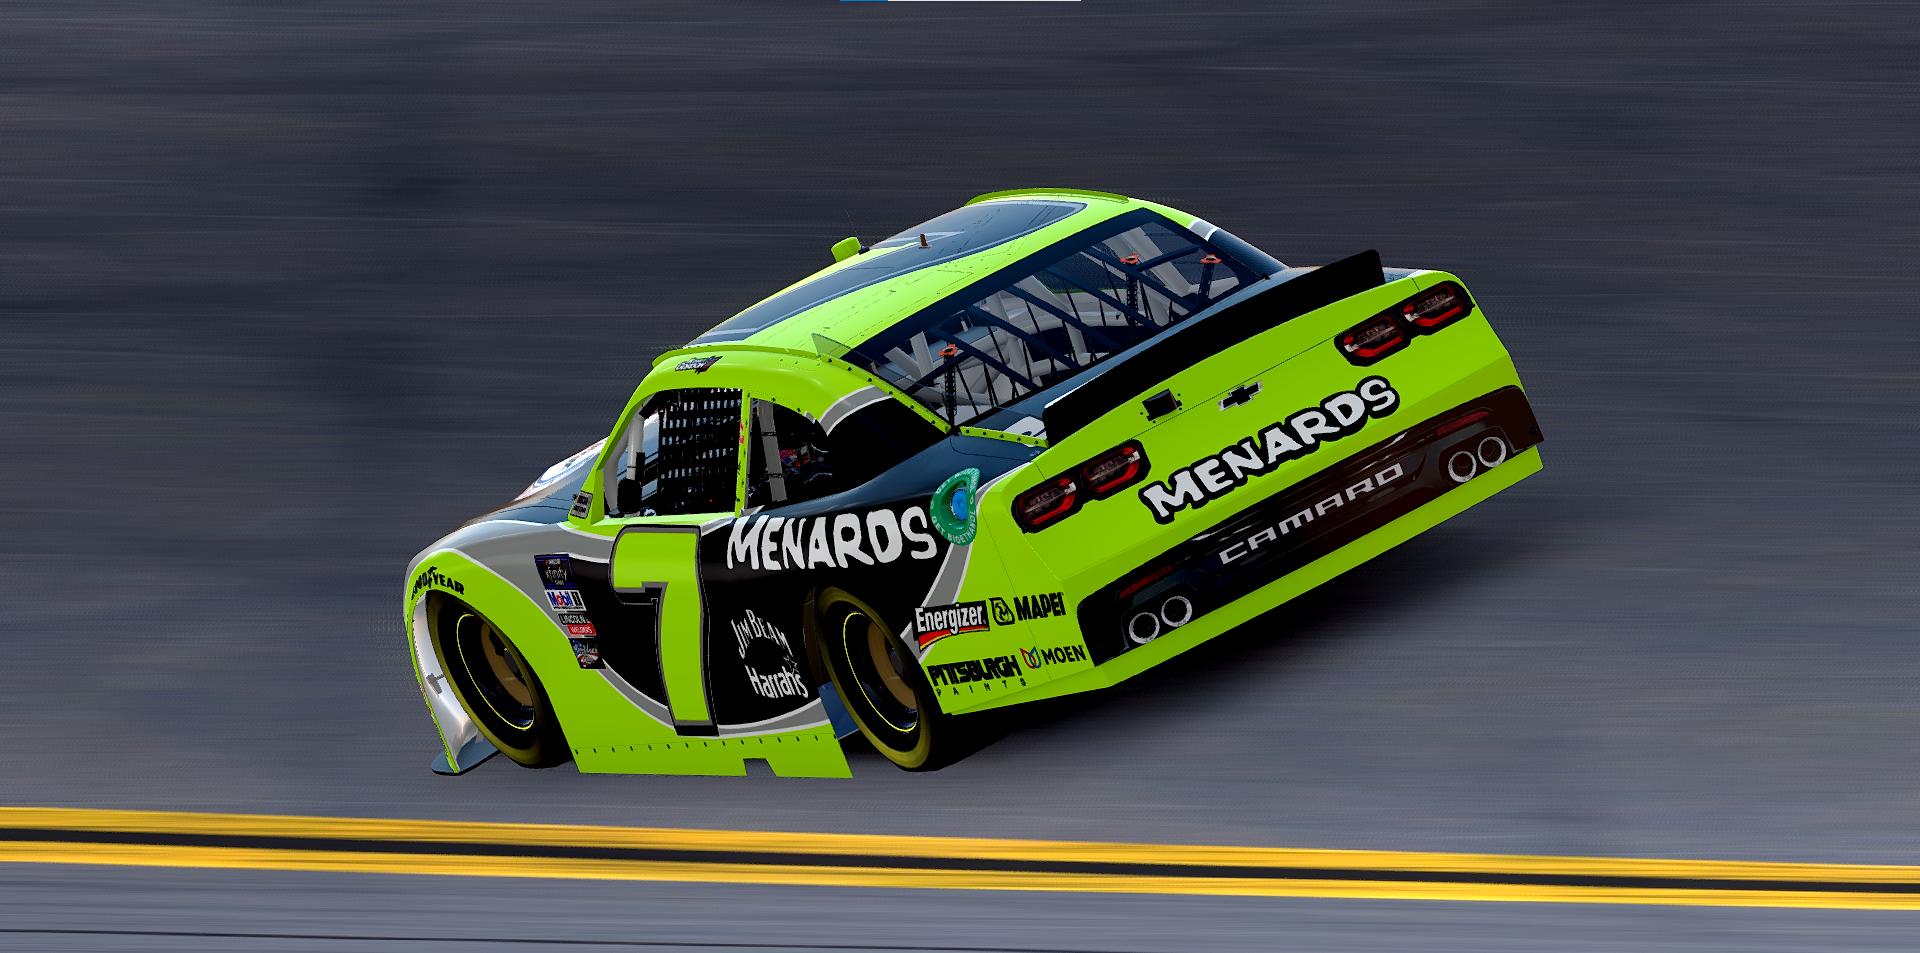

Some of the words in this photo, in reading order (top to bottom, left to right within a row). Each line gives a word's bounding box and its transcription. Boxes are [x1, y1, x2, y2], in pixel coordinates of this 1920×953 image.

[1143, 378, 1396, 518] MENARDS
[726, 506, 938, 571] MENARDS
[1219, 462, 1404, 565] CAMARO
[611, 525, 716, 735] 7
[914, 603, 984, 635] Energizer
[1013, 591, 1067, 621] MAPEI
[731, 618, 753, 659] JIM
[745, 608, 793, 658] BEAM
[1041, 645, 1088, 666] MOEN
[935, 680, 1027, 697] PAINTS
